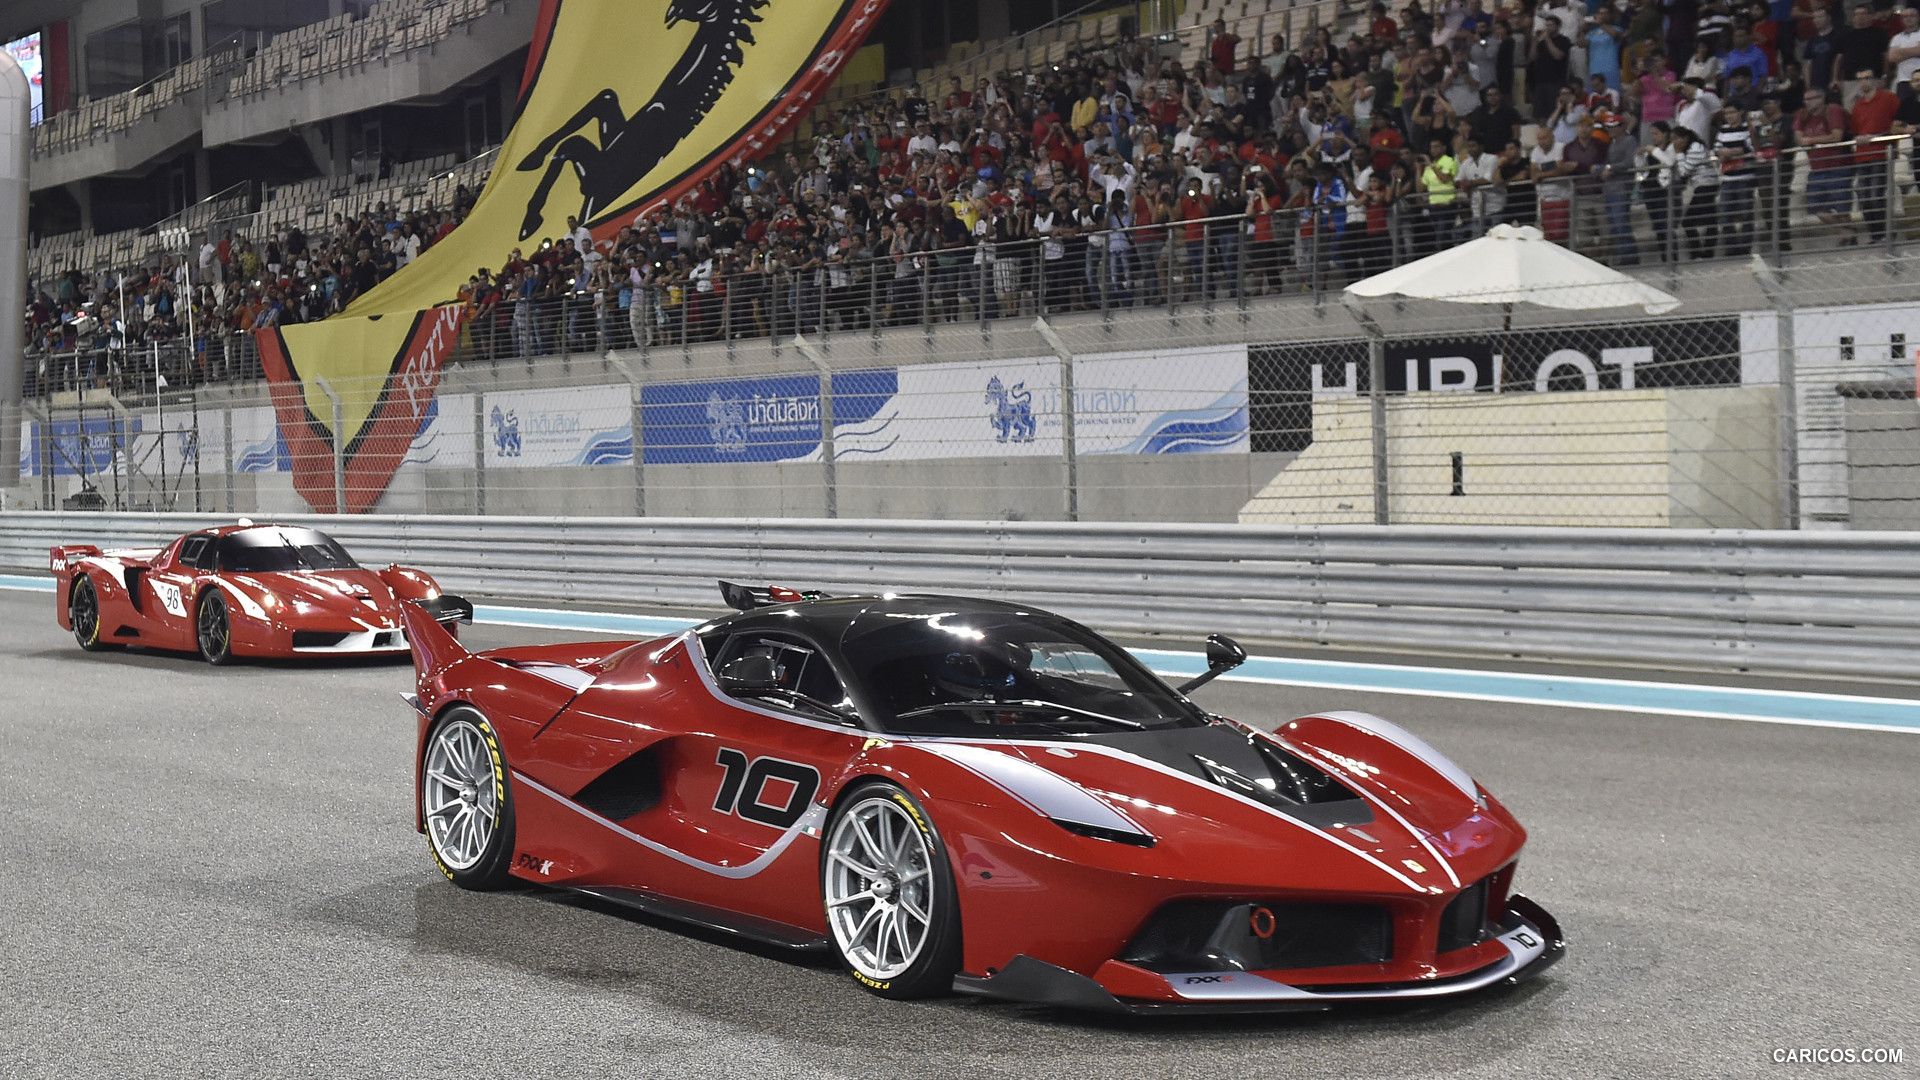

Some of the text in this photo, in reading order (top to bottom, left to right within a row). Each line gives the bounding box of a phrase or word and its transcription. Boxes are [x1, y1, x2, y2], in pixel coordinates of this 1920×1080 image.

[1311, 346, 1654, 397] HBOT
[166, 588, 179, 609] 98
[712, 747, 821, 830] 10
[1510, 932, 1538, 949] 10
